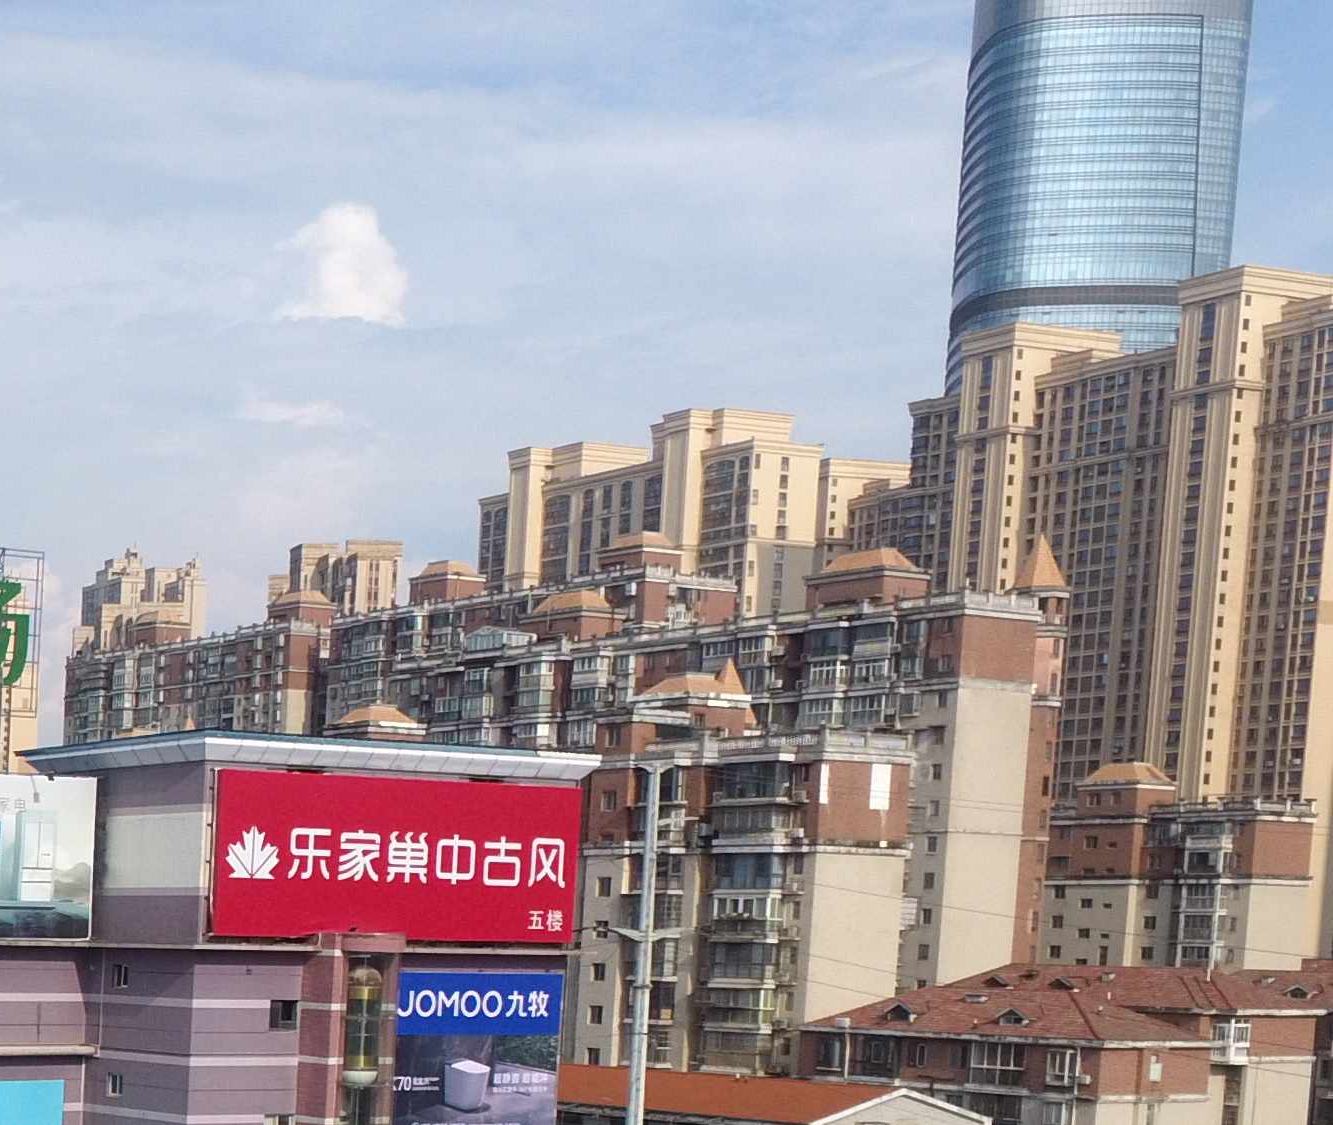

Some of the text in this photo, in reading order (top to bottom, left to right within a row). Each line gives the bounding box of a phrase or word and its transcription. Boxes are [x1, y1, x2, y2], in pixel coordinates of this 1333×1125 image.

[288, 827, 567, 888] 乐家巢中古风
[528, 909, 564, 932] 五楼
[396, 989, 550, 1018] JOMOO 九牧
